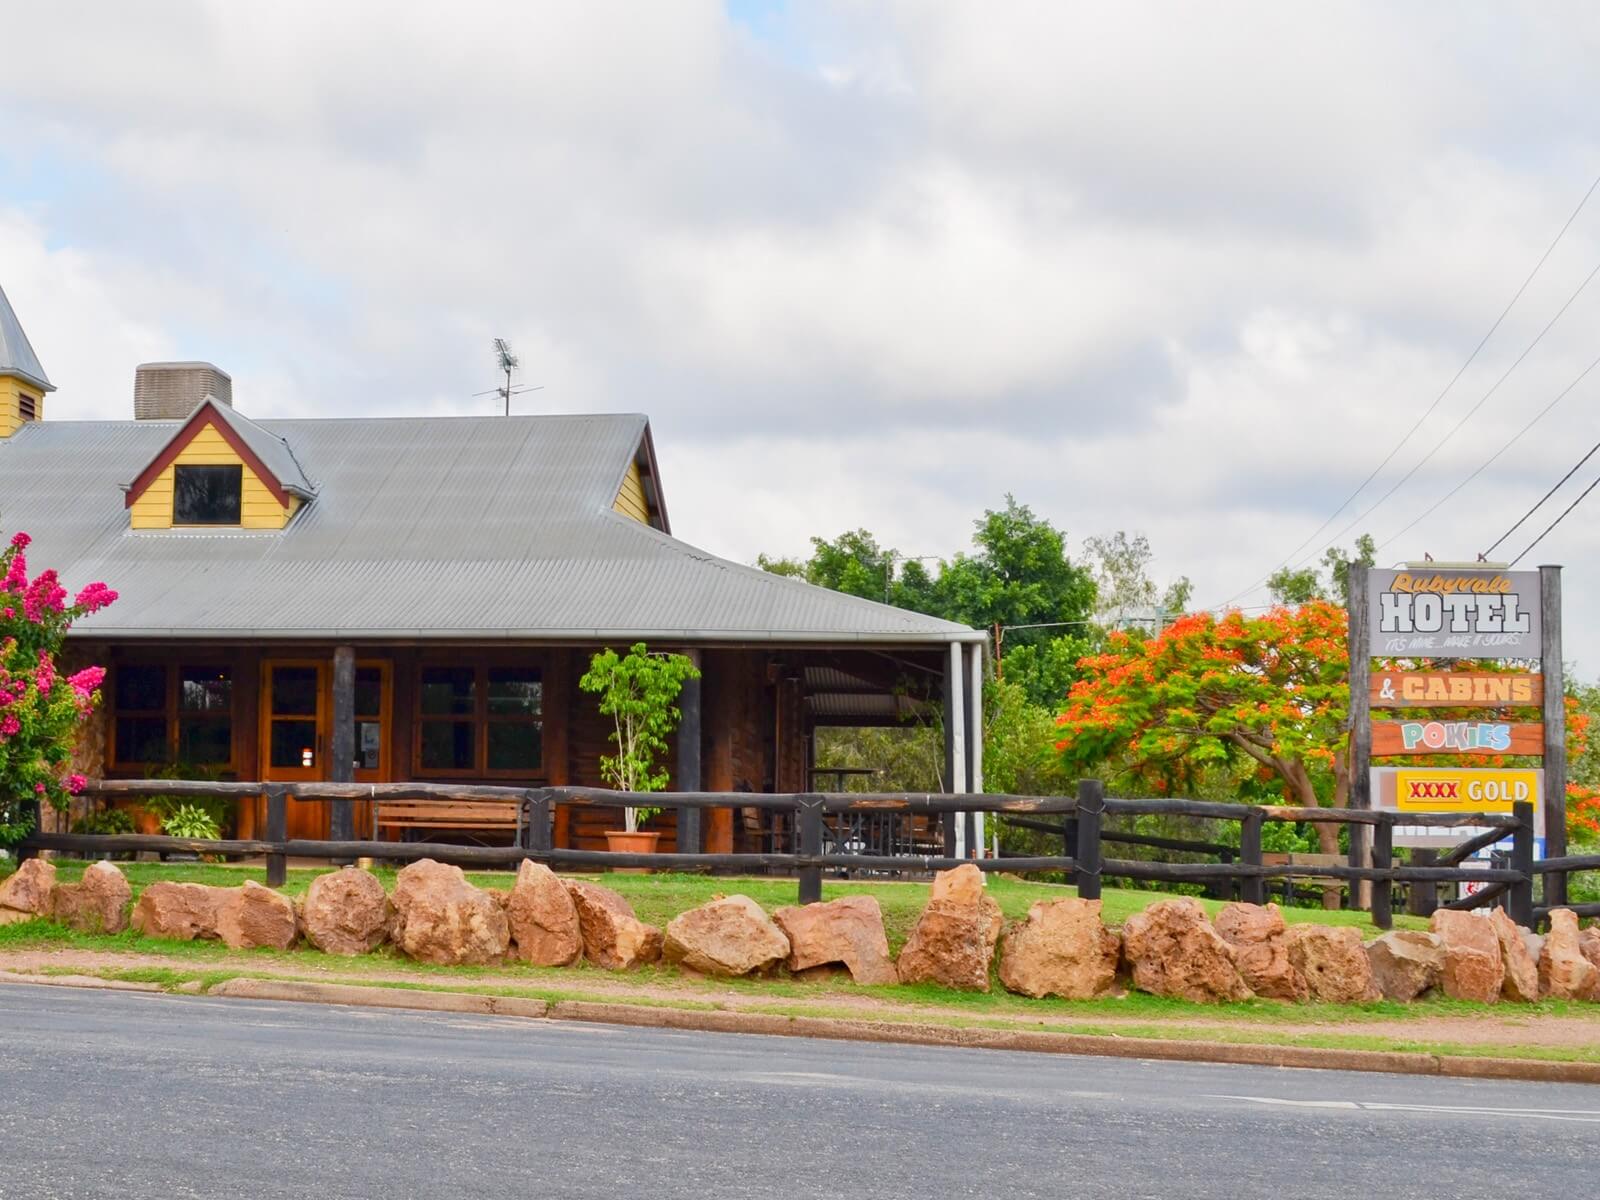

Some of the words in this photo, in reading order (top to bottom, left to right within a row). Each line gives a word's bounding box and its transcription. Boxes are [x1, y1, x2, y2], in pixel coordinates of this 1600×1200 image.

[1389, 573, 1512, 594] Rubyvale
[1380, 592, 1531, 633] HOTEL
[1379, 678, 1396, 700] &
[1402, 676, 1533, 701] CABINS
[1401, 722, 1512, 751] POKIES
[1410, 782, 1459, 798] XXXX
[1467, 780, 1530, 801] GOLD
